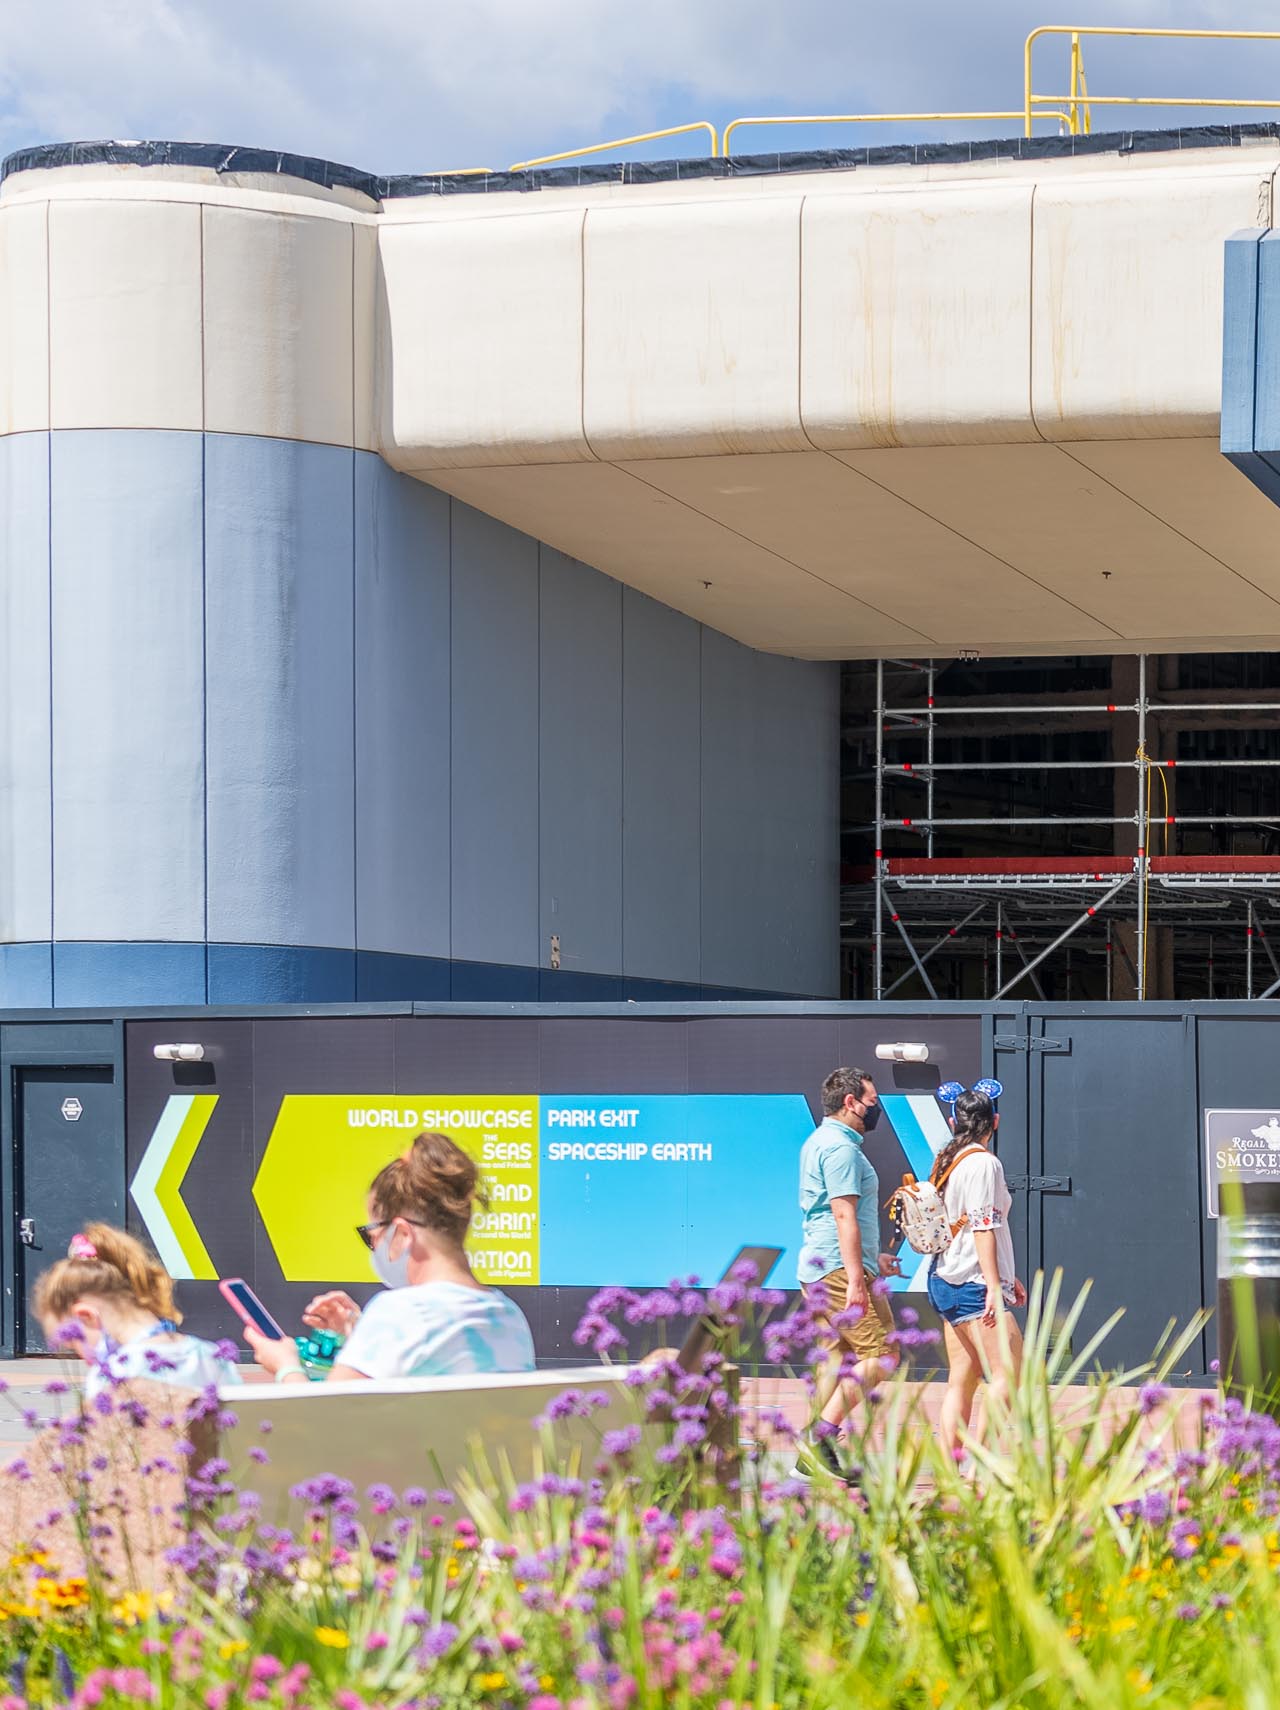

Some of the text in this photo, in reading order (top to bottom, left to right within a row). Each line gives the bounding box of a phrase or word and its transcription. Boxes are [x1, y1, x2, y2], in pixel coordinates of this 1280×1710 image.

[348, 1109, 532, 1128] WORLD SHOWCASE
[547, 1109, 640, 1128] PARK EXIT
[483, 1134, 498, 1142] THE
[483, 1142, 532, 1161] SEAS
[548, 1142, 713, 1161] SPACESHIP EARTH
[471, 1212, 536, 1231] OARIN'
[464, 1250, 532, 1269] NATION
